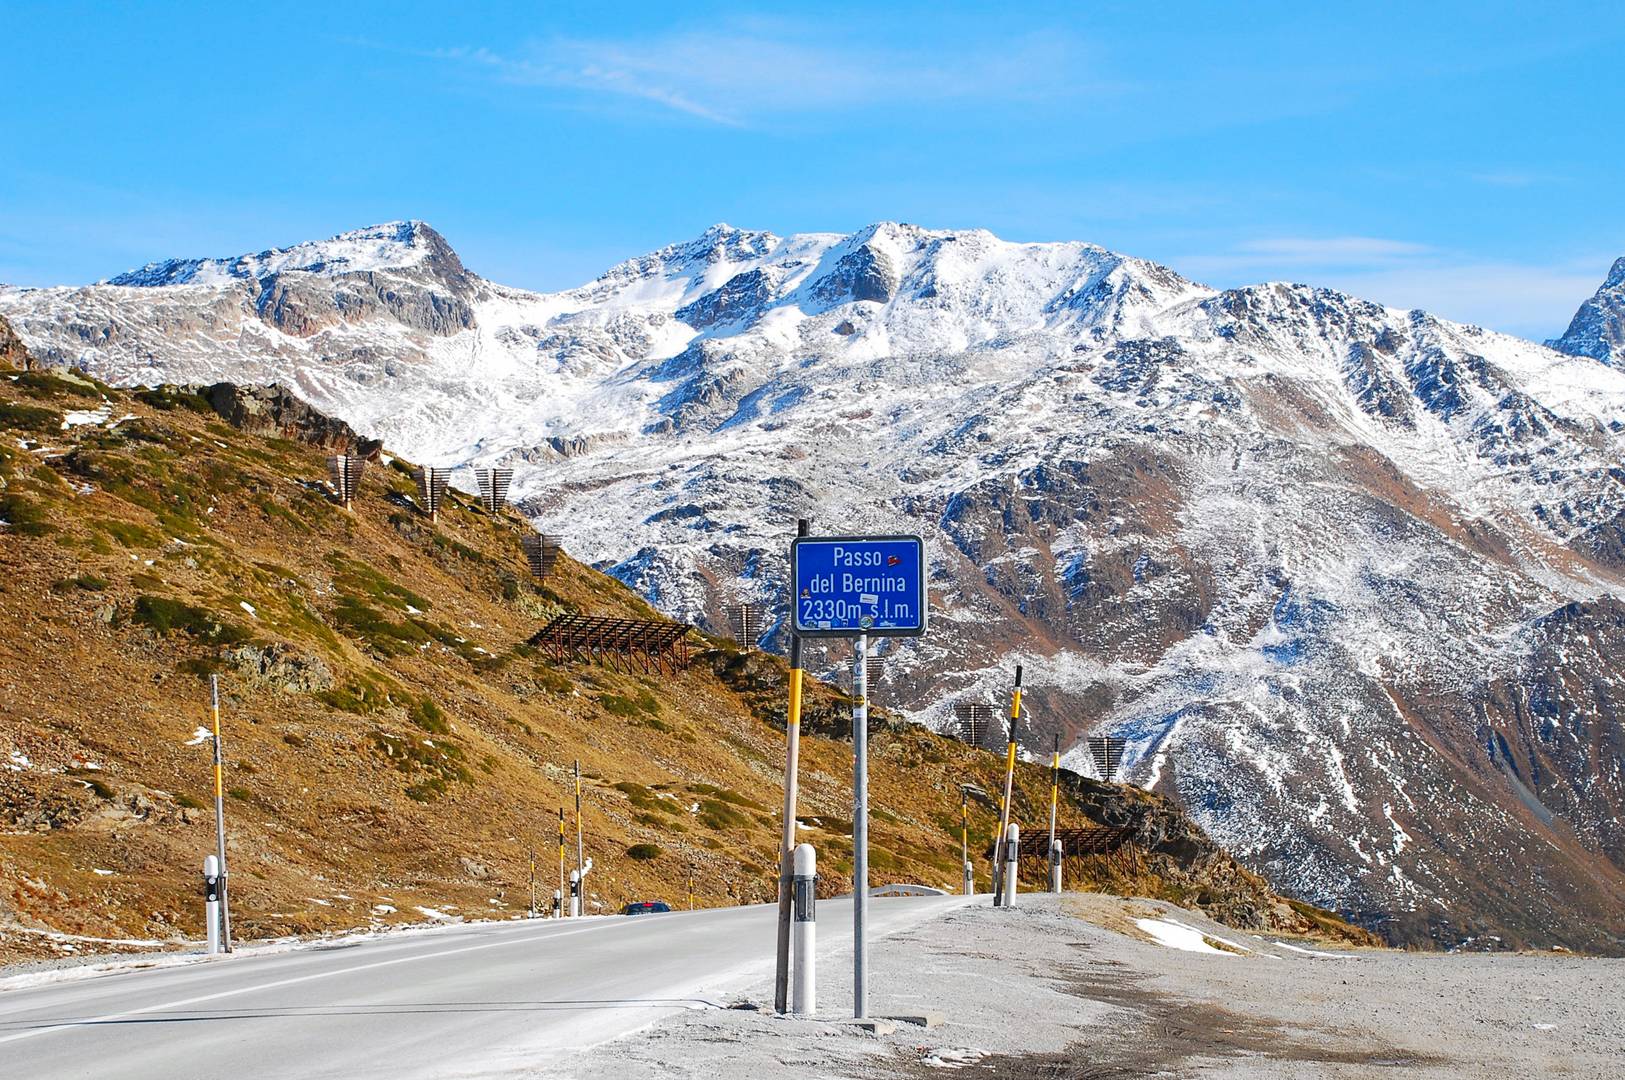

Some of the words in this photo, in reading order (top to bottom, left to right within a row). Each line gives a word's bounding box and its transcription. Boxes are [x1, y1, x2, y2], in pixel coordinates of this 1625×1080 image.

[833, 547, 882, 567] Passo
[810, 573, 834, 593] del
[842, 573, 906, 593] Bernina
[803, 599, 861, 620] 2330m
[870, 599, 914, 619] s.l.m.
